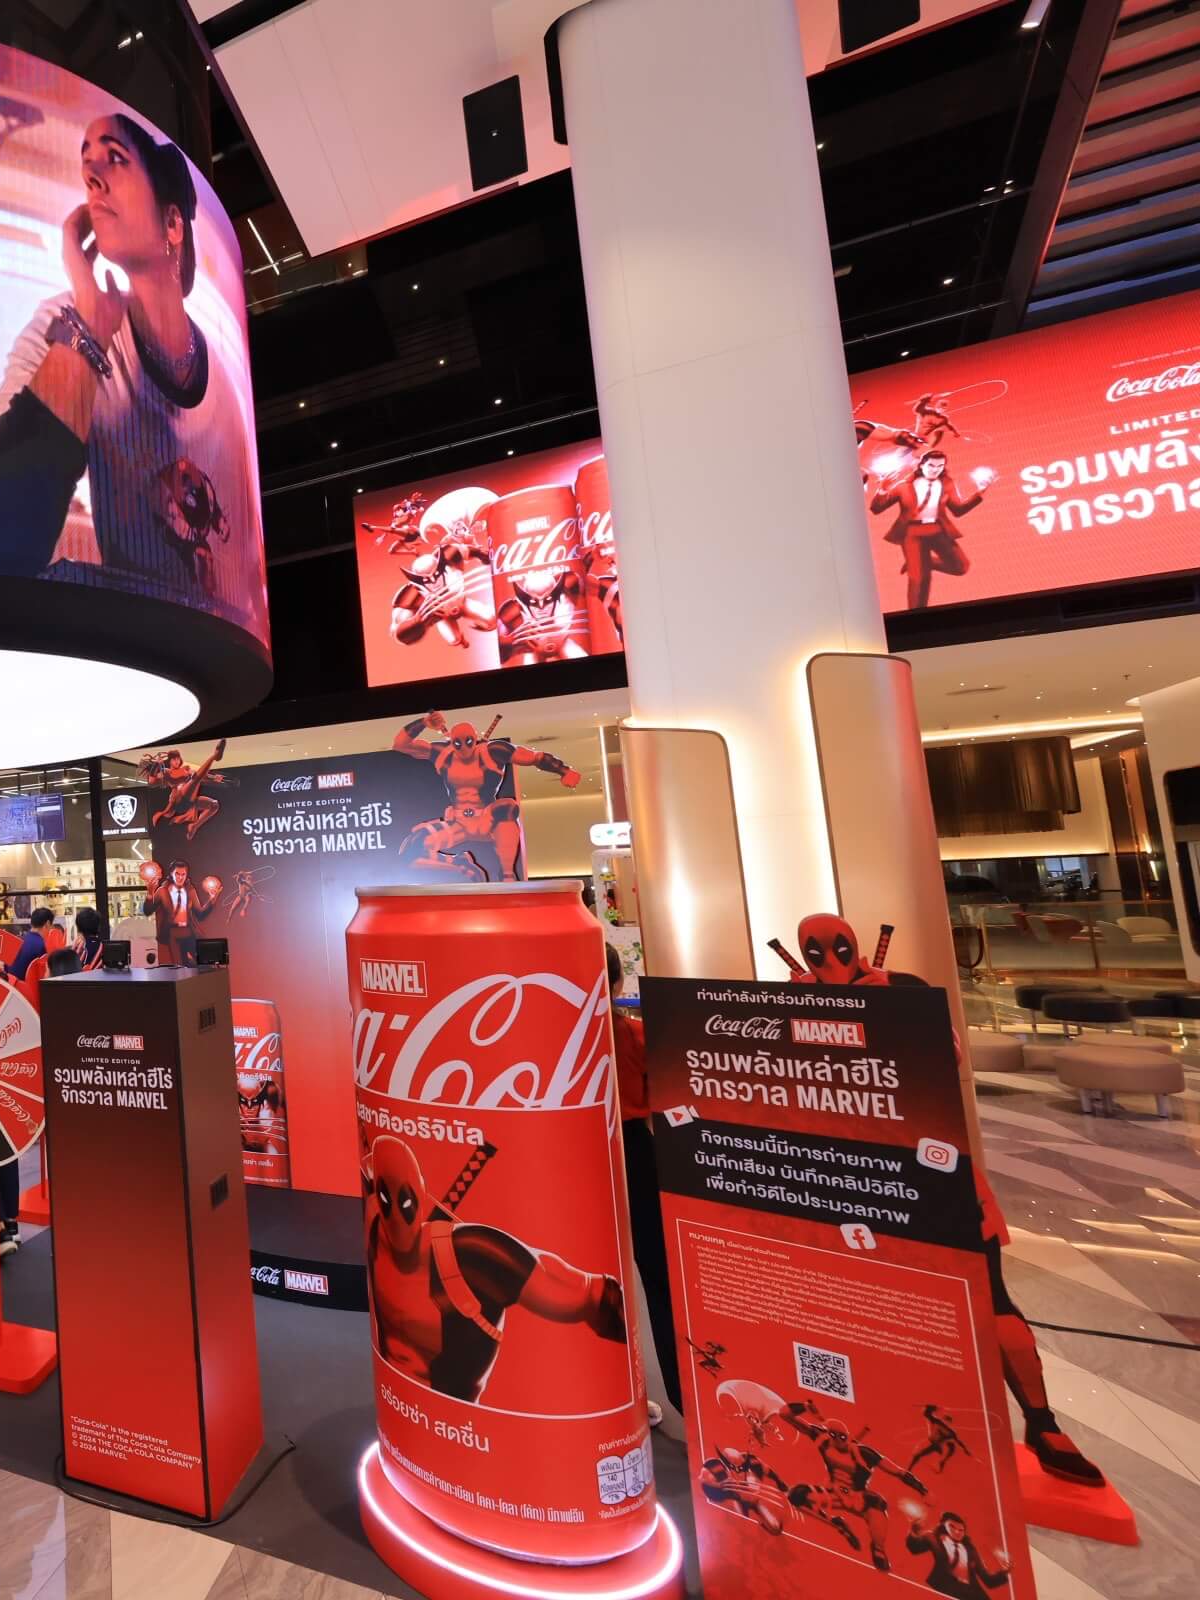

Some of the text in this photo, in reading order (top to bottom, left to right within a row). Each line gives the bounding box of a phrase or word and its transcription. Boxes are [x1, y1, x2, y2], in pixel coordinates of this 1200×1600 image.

[271, 771, 354, 794] Coca-Cola MARVEL
[277, 797, 352, 809] LIMITED EDITION
[243, 803, 393, 836] รวมพลังเหล่าฮีโร่
[252, 831, 386, 857] จักรวาล MARVEL
[360, 958, 428, 998] MARVEL
[697, 988, 866, 1009] ท่านกำลังเข้าร่วมกิจกรรม
[76, 1034, 145, 1051] Coca-Cola MARVEL
[704, 1014, 866, 1048] Coca-Cola MARVEL
[54, 1065, 173, 1089] รวมพลังเหล่าฮีโร่
[686, 1049, 900, 1089] รวมพลังเหล่าฮีโร่
[61, 1085, 168, 1110] จักรวาล MARVEL
[688, 1070, 904, 1121] จักรวาล MARVEL
[700, 1129, 902, 1173] กิจกรรมนี้มีการถ่ายภาพ
[694, 1150, 919, 1201] บันทึกเสียง บันทึกคลิปวิดีโอ
[706, 1172, 911, 1225] เพื่อทำวิดีโอประมวลภาพ
[284, 1270, 329, 1295] MARVEL
[381, 1384, 429, 1430] อร่อยซ่า
[434, 1420, 490, 1452] สดชื่น
[71, 1424, 106, 1438] trademark
[115, 1434, 129, 1444] The
[130, 1439, 166, 1454] Coca-Cola
[79, 1441, 97, 1452] 2024
[98, 1447, 128, 1461] MARVEL
[118, 1427, 130, 1436] the
[131, 1431, 169, 1446] registered
[78, 1434, 97, 1444] 2024
[98, 1438, 112, 1447] THE
[113, 1442, 155, 1459] COCA-COLA
[156, 1453, 194, 1470] COMPANY
